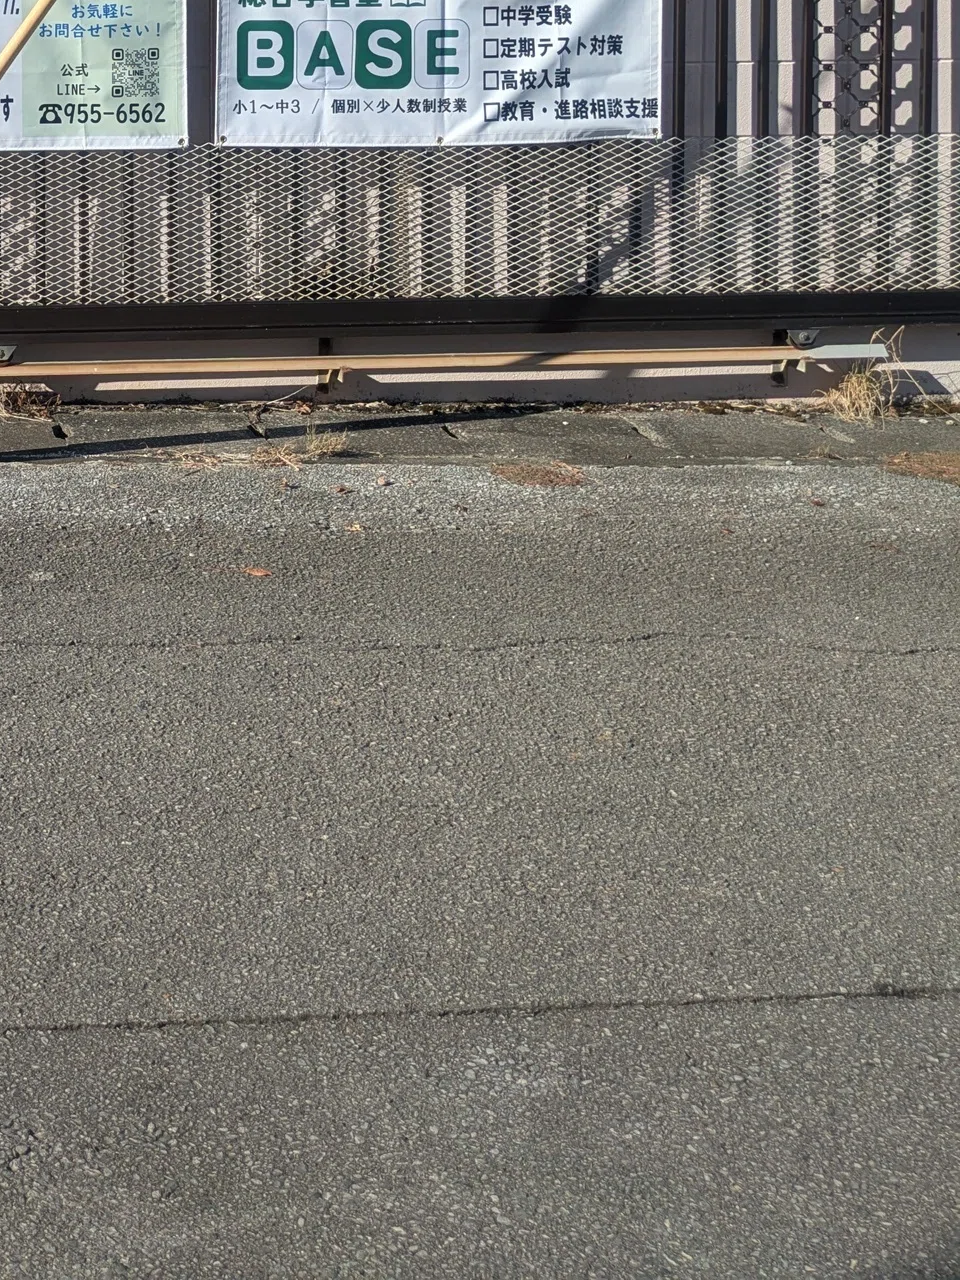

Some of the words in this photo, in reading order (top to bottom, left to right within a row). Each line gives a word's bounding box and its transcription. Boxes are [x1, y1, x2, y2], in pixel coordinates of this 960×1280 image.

[71, 3, 133, 19] お気軽に
[243, 27, 463, 80] BASE
[60, 63, 89, 77] 公式
[128, 69, 145, 77] LINE
